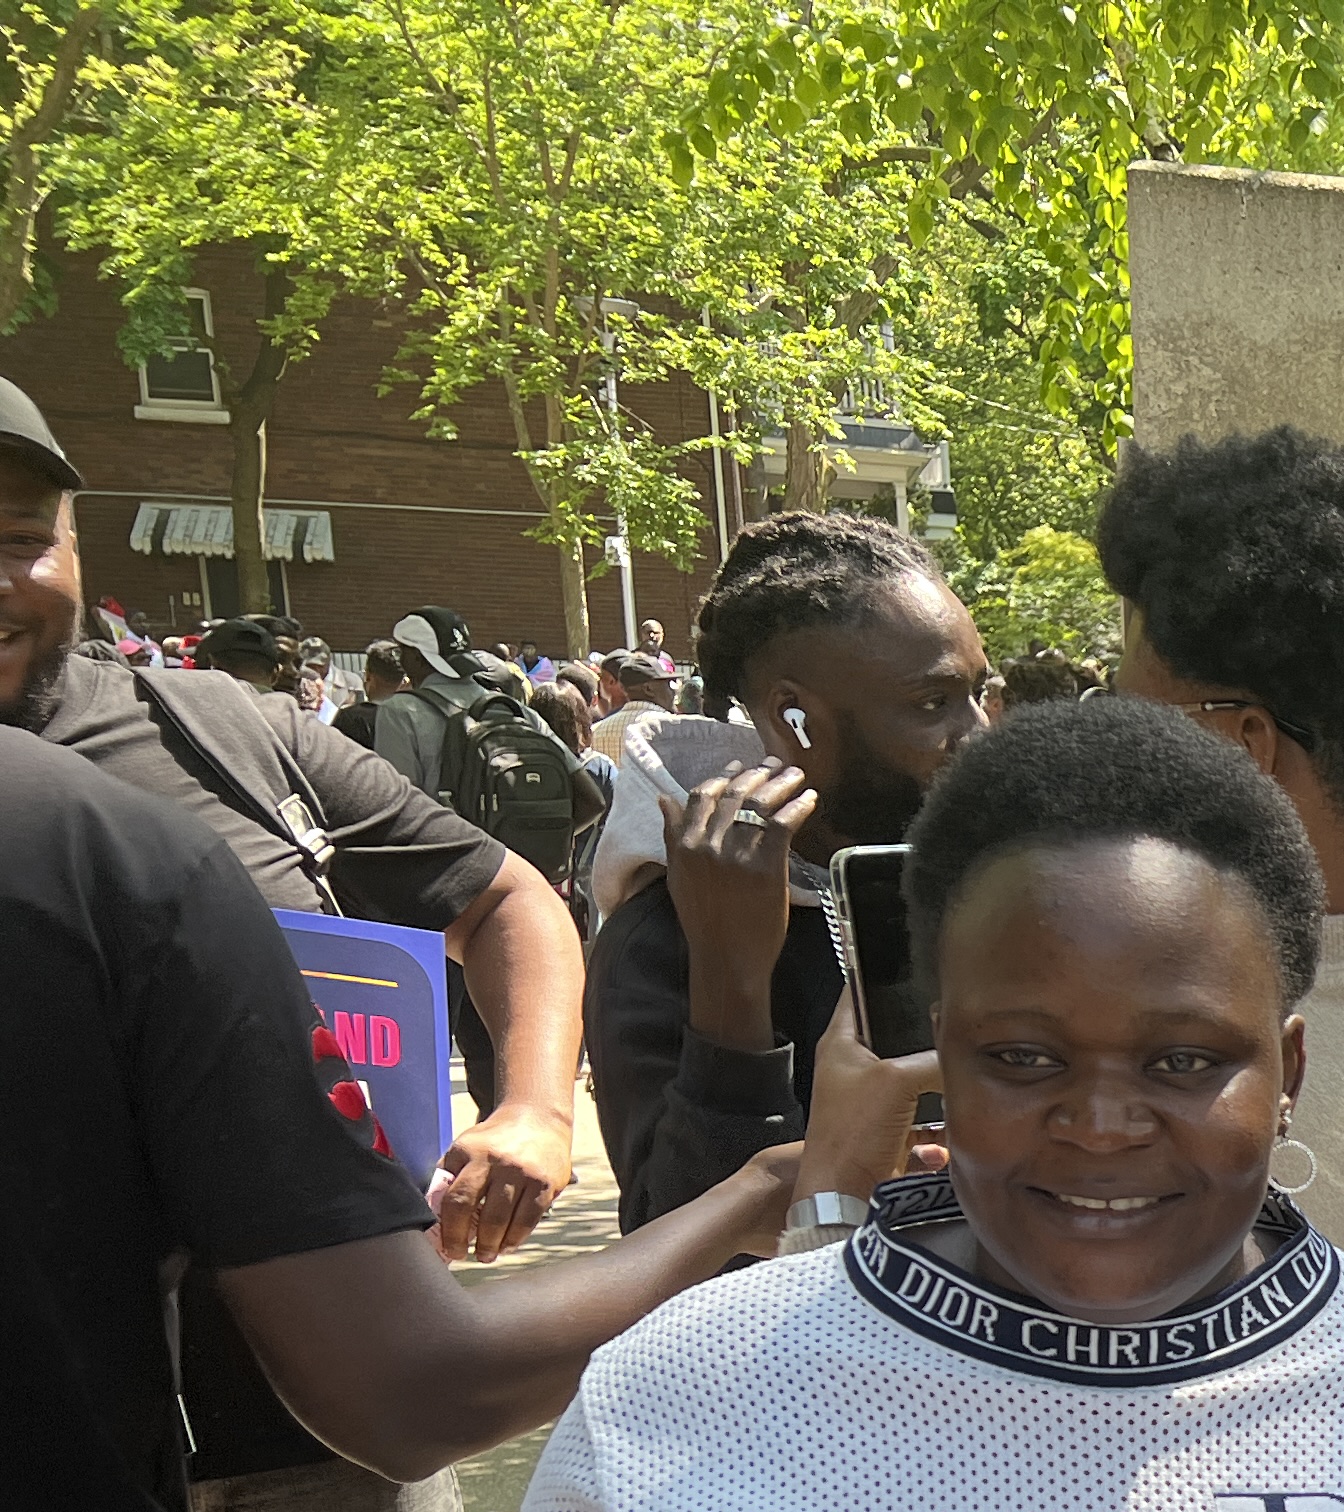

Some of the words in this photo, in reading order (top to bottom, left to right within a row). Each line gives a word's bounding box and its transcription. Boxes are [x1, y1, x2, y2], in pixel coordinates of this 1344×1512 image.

[318, 1003, 401, 1067] ND
[898, 1262, 999, 1342] DIOR
[1021, 1275, 1294, 1366] CHRISTIAN
